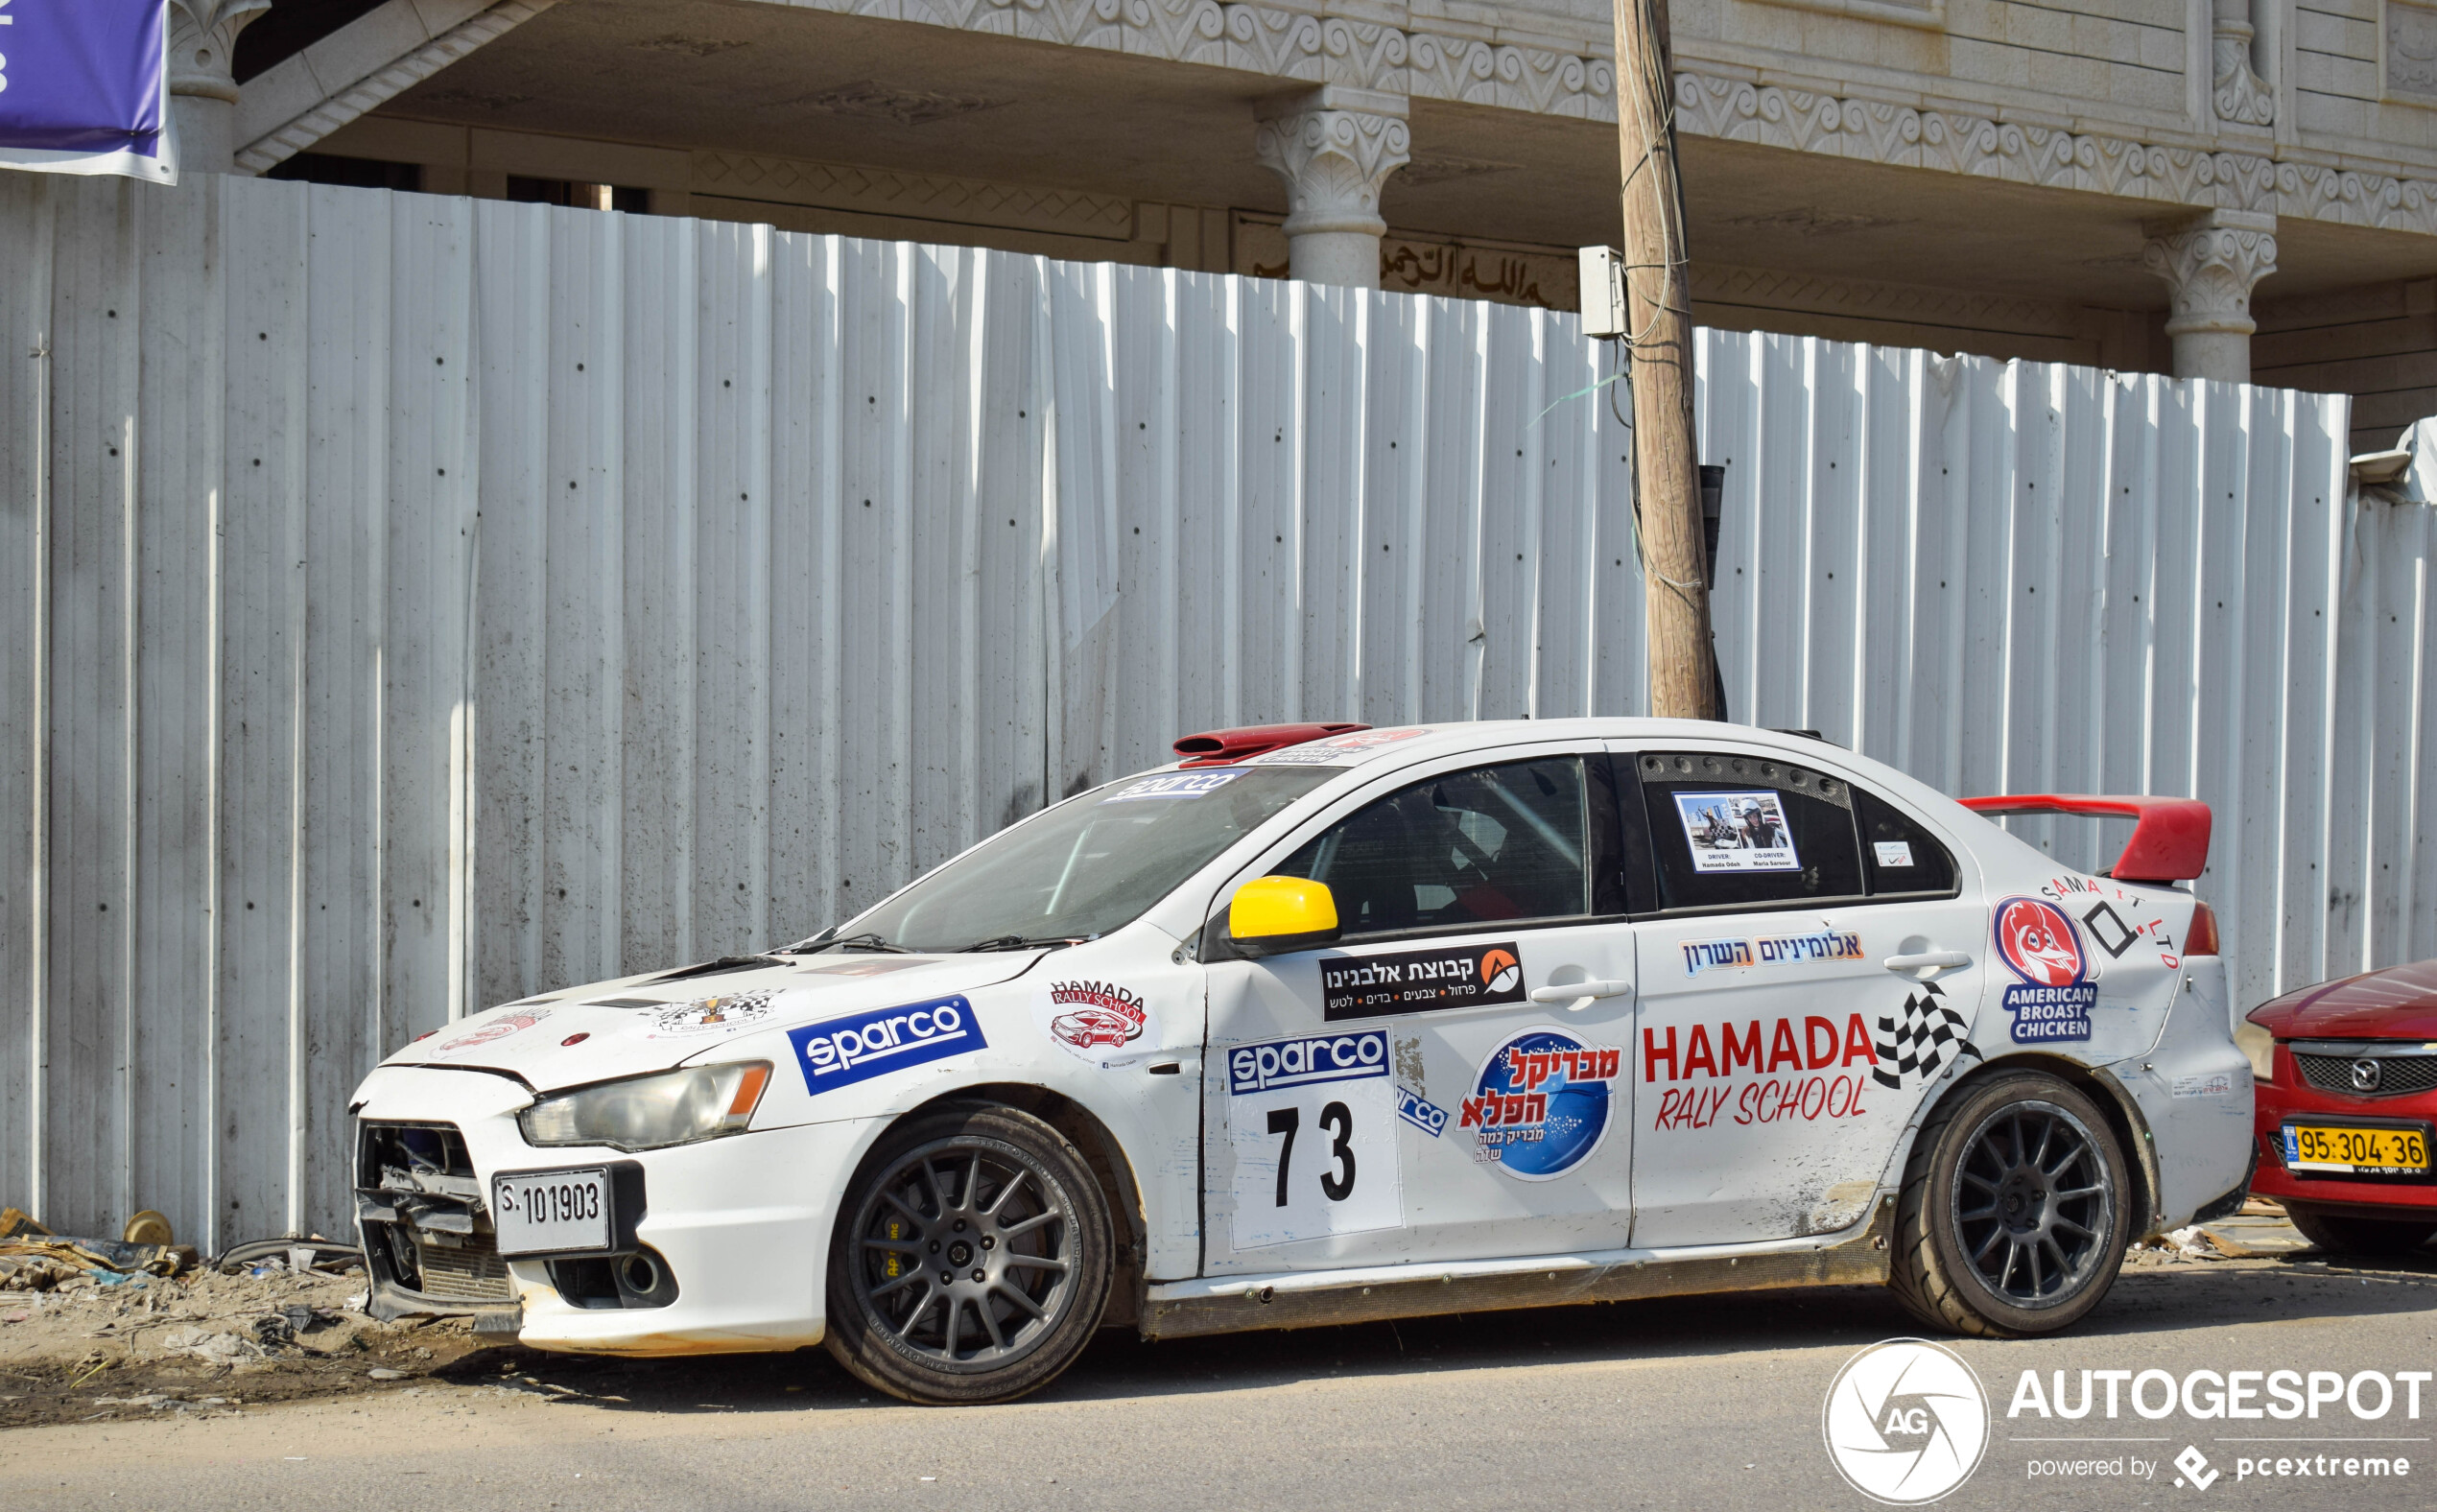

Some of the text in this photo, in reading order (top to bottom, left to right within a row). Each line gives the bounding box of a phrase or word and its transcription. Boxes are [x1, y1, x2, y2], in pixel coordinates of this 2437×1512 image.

[2041, 875, 2103, 901] SAMA
[1682, 932, 1862, 974] אלומיניום השרון
[1326, 957, 1475, 989] קבוצת אלבגינו
[1050, 980, 1144, 1012] HAMADA
[1366, 992, 1391, 1005] בדים
[1403, 987, 1437, 1001] צבעים
[1447, 983, 1477, 997] פרזול
[2006, 986, 2094, 1005] AMERICAN
[1053, 992, 1144, 1025] RALLY SCHOOL
[2020, 1004, 2083, 1021] BROAST
[806, 1003, 962, 1072] sparco
[2015, 1020, 2088, 1038] CHICKEN
[1232, 1034, 1384, 1091] sparco
[1643, 1012, 1880, 1084] HAMADA
[1509, 1048, 1621, 1091] מבריקל
[1459, 1089, 1548, 1128] הפלא
[1655, 1074, 1868, 1132] RALY SCHOOL
[1505, 1127, 1545, 1146] מבריק
[1266, 1100, 1357, 1208] 73
